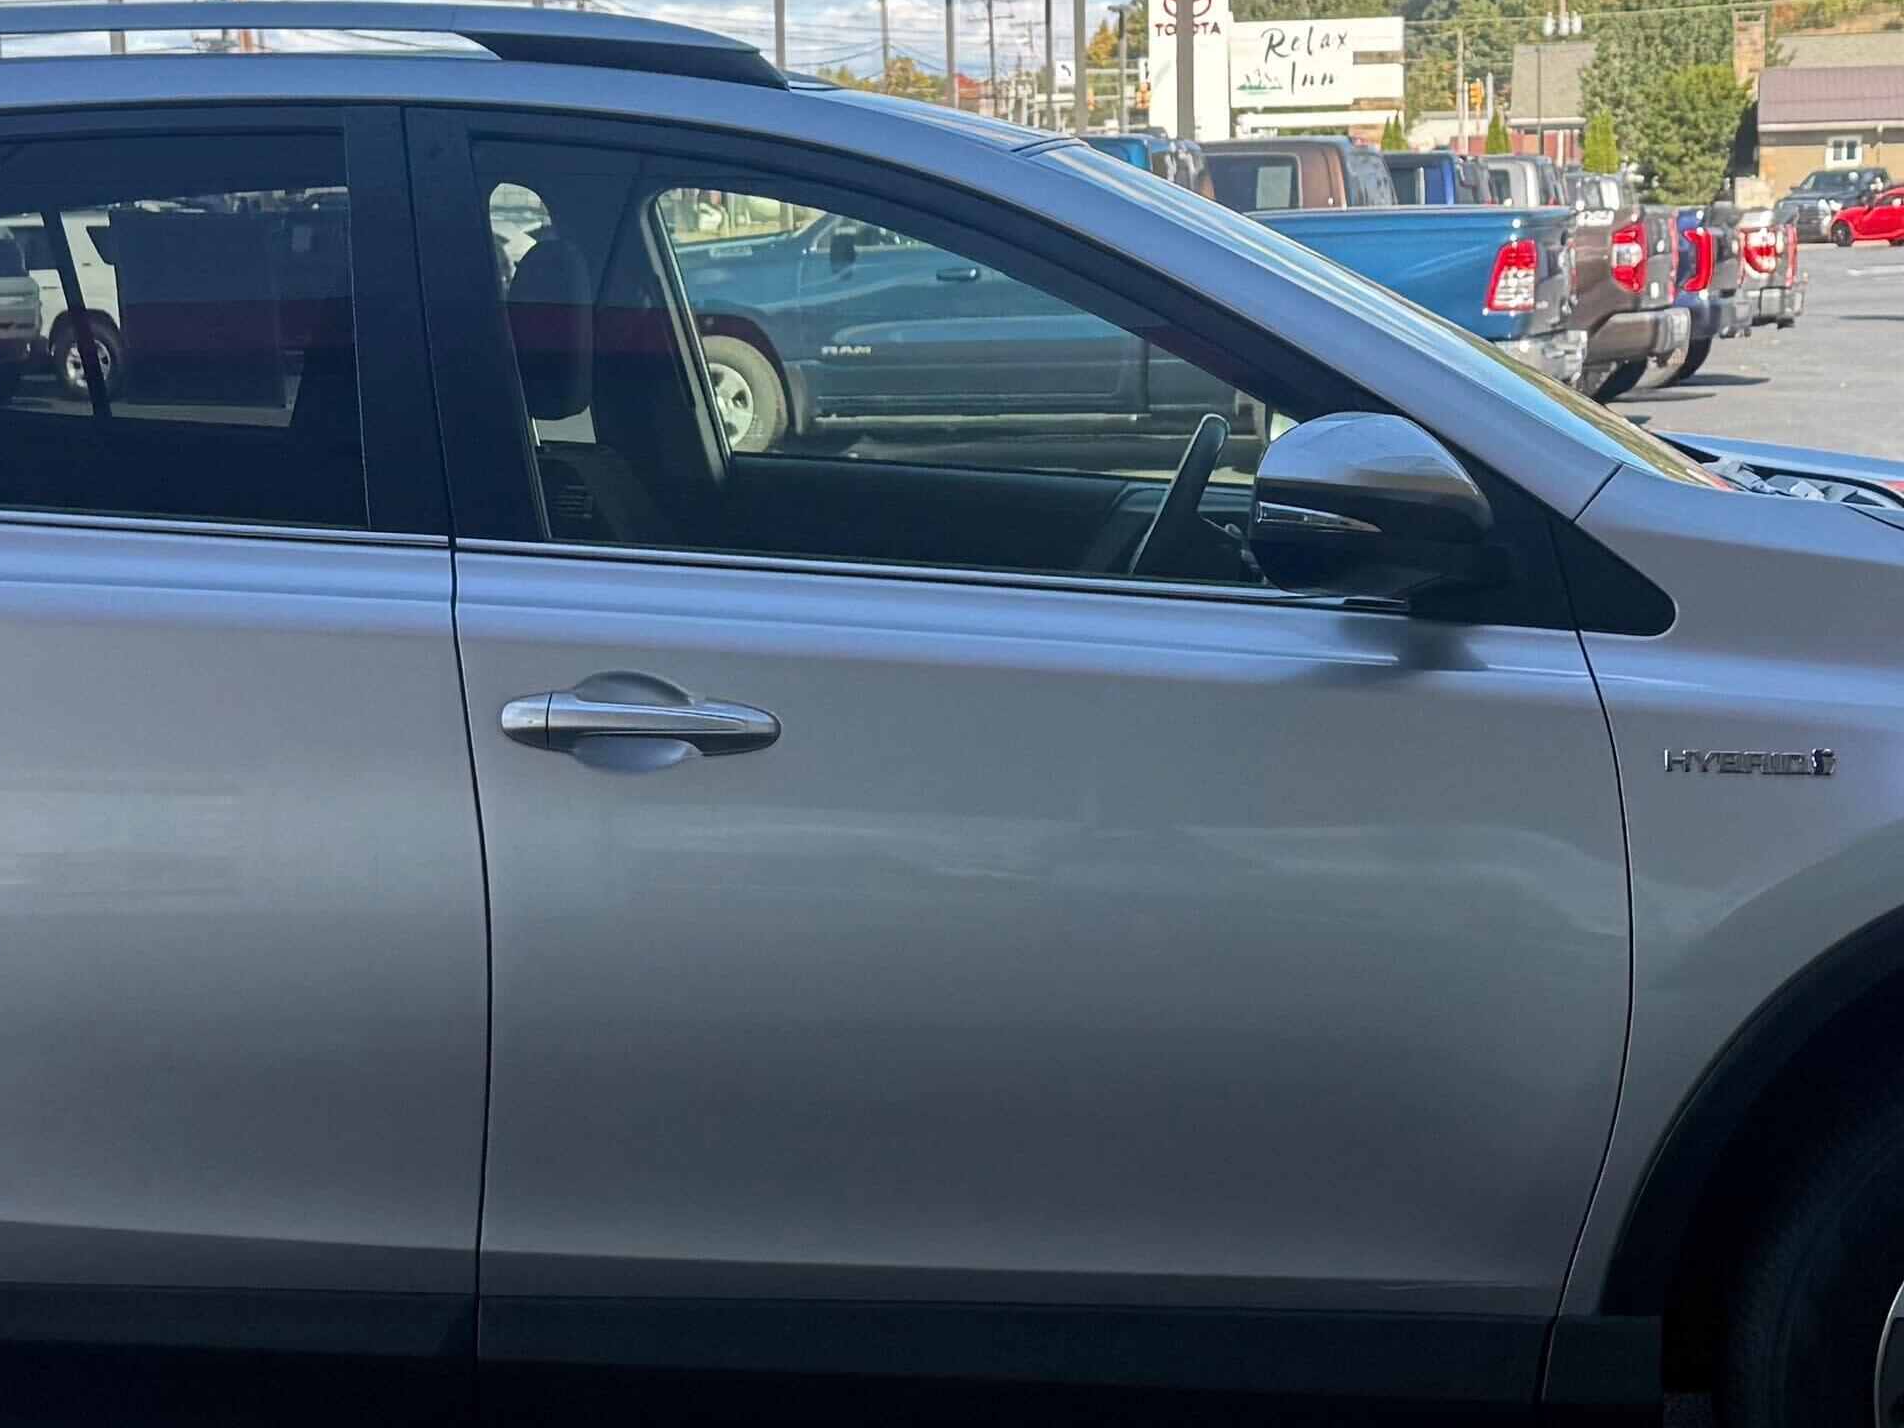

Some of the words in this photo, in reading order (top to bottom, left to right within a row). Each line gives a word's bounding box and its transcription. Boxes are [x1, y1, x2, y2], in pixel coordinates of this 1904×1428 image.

[1155, 22, 1221, 37] TOOTA
[1261, 26, 1348, 64] Relax
[1291, 61, 1335, 96] Inn
[821, 345, 872, 357] RAM
[1663, 748, 1812, 775] HYBRID
